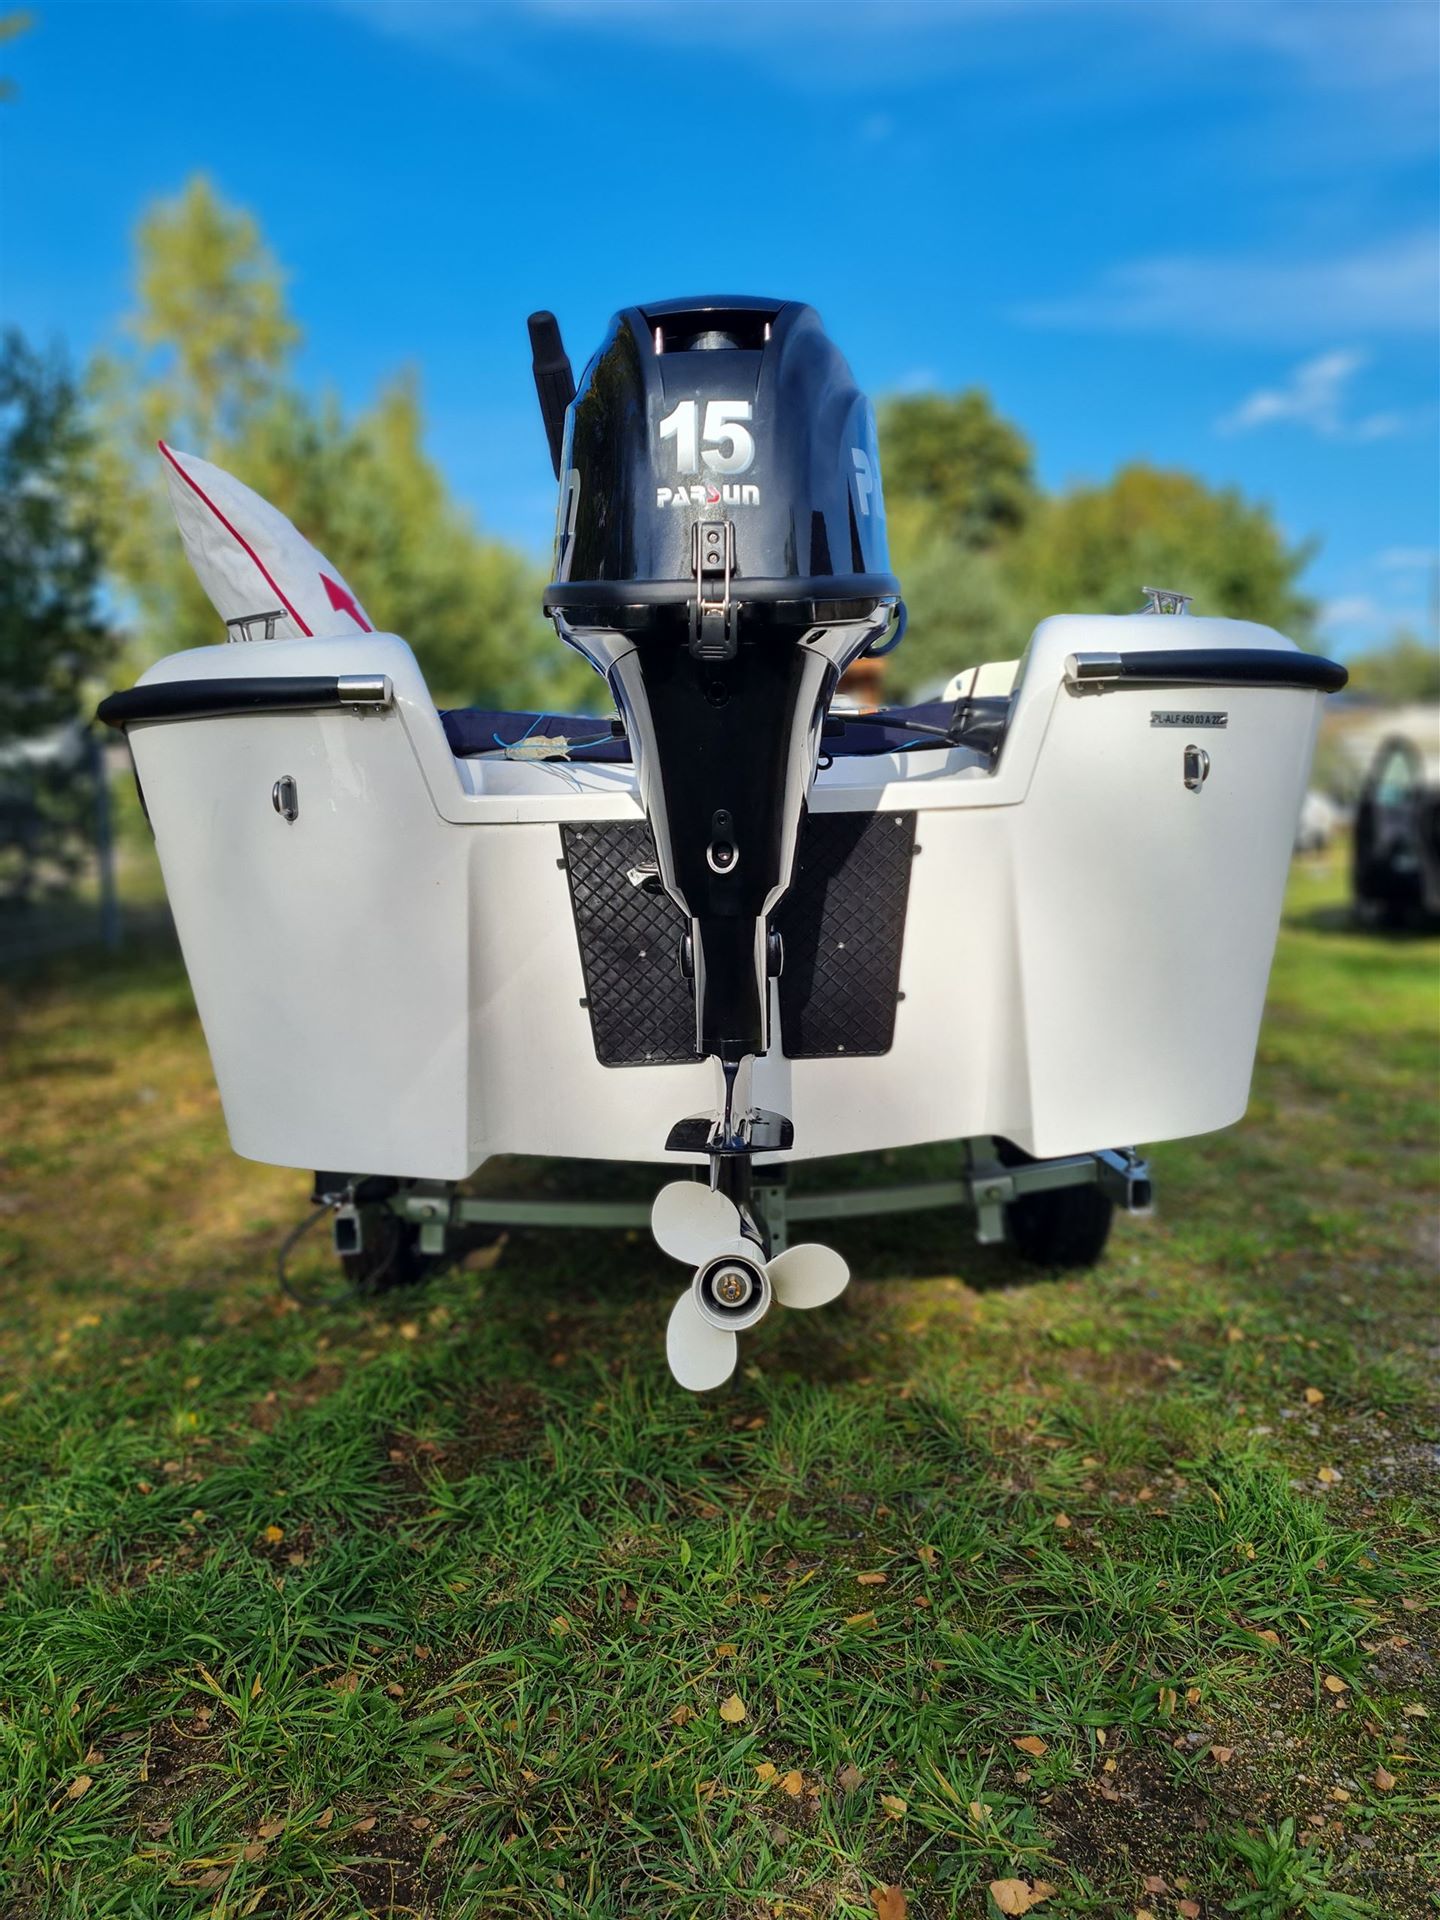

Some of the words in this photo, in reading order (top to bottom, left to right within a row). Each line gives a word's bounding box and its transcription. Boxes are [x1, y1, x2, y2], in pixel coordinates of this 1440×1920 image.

[659, 400, 756, 475] 15
[656, 483, 760, 508] PARSUN
[1182, 714, 1195, 724] 450
